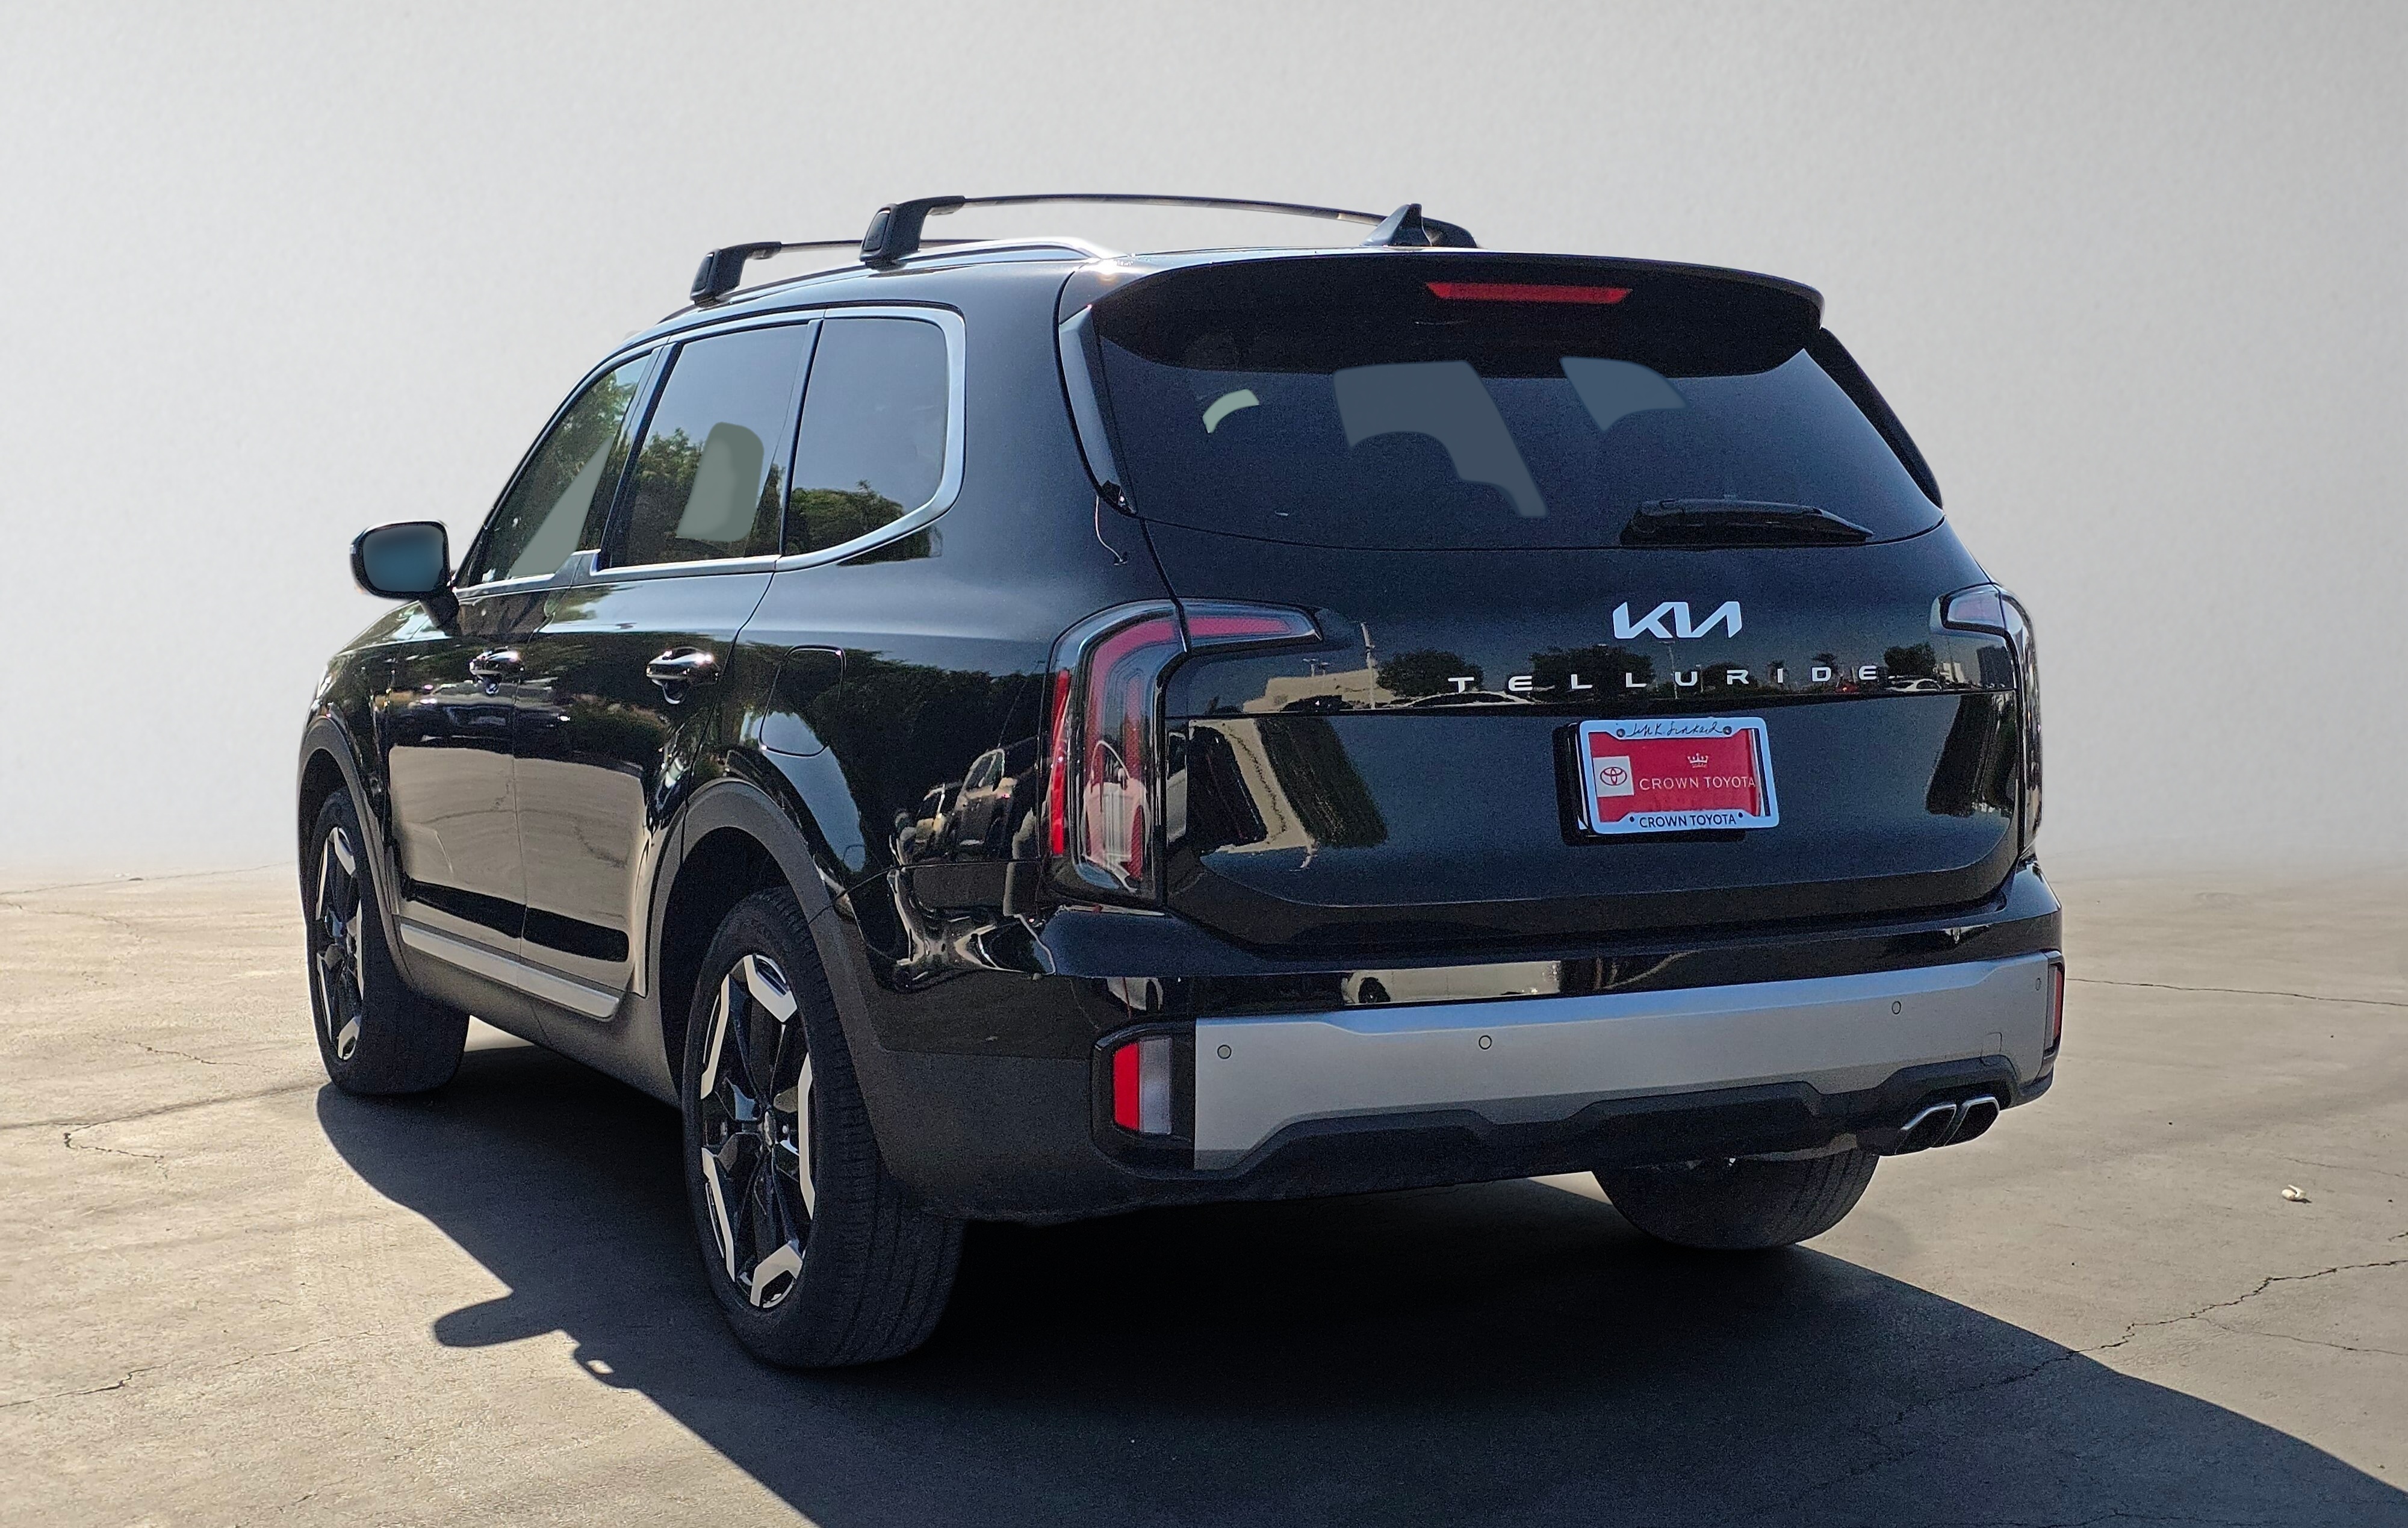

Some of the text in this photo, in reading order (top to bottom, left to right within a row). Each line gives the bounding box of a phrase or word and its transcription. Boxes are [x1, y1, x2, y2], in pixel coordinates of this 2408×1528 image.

[1612, 601, 1743, 639] KIA
[1447, 665, 1878, 693] TELLURIDE
[1639, 775, 1756, 790] CROWN TOYOTA
[1639, 813, 1737, 828] CROWN TOYOTA
